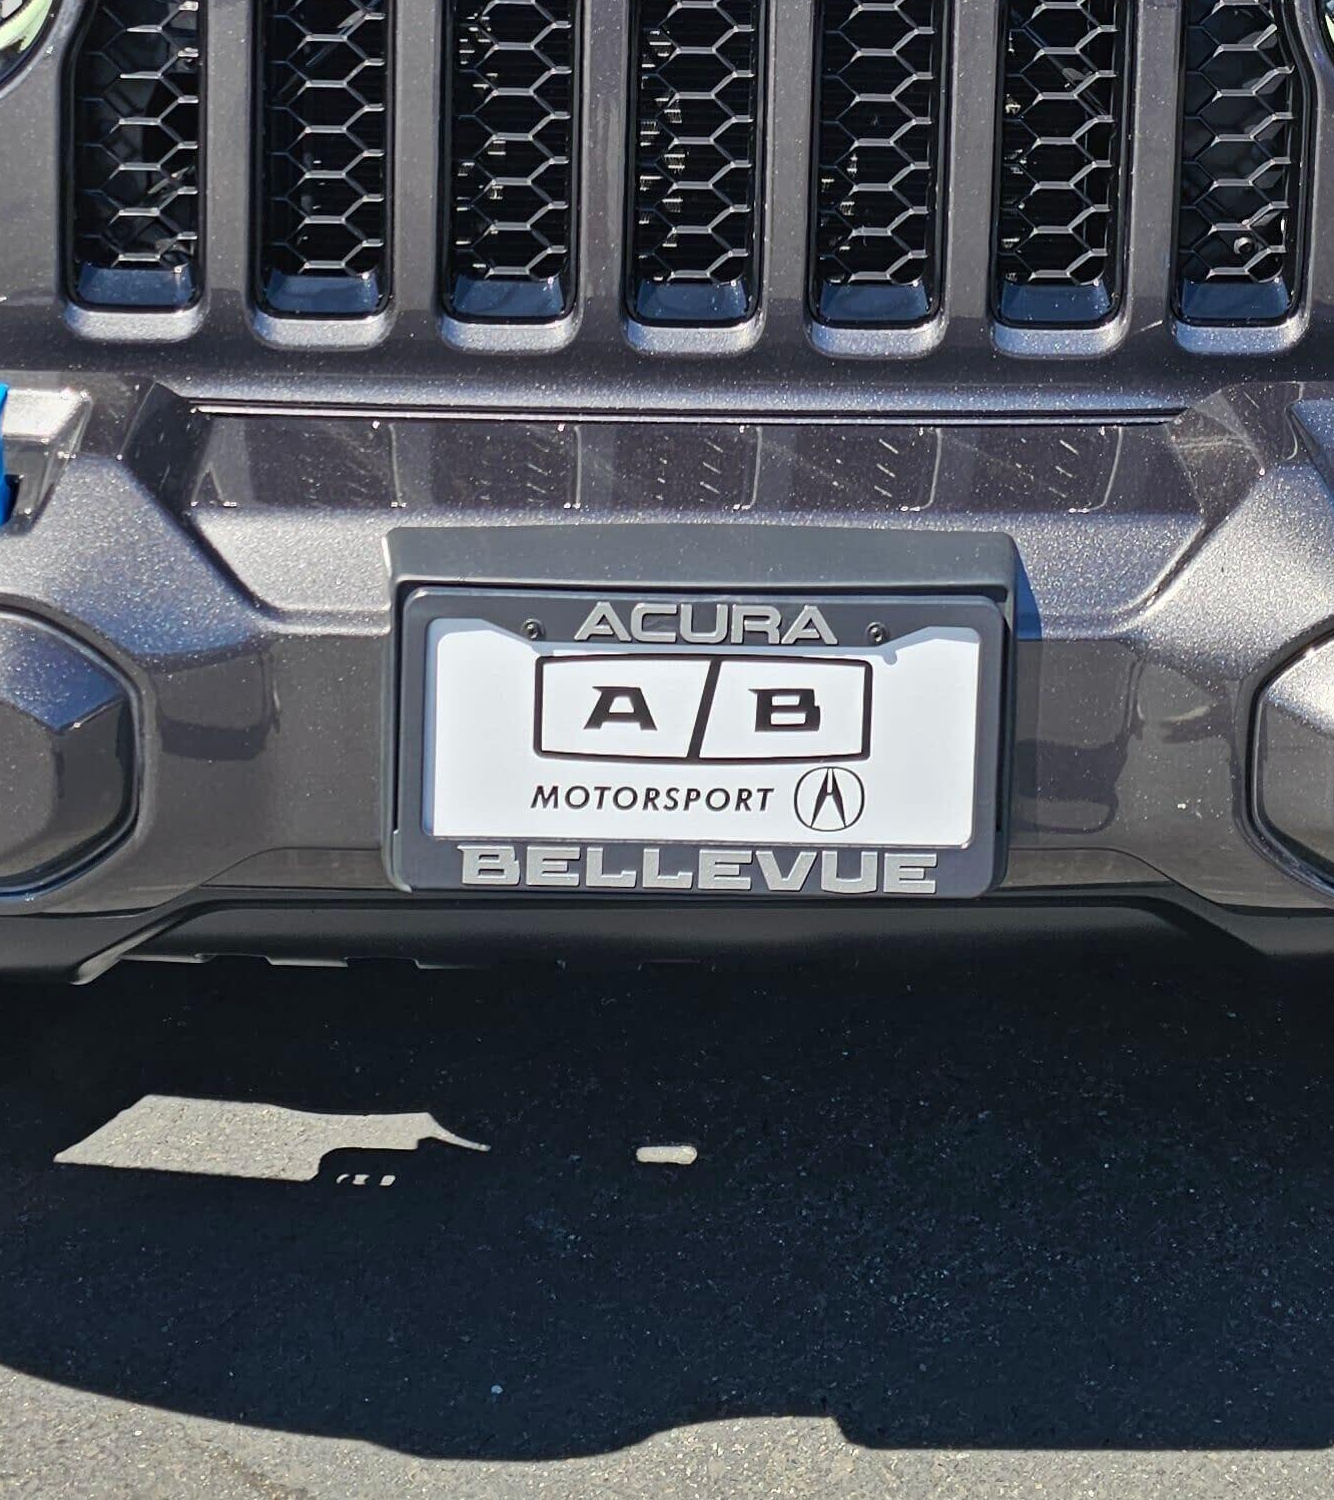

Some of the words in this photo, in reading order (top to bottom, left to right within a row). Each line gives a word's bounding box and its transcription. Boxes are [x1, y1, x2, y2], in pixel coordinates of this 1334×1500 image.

[573, 600, 839, 646] ACURA
[530, 784, 775, 813] MOTORSPORT
[457, 844, 938, 895] BELLEVUE
